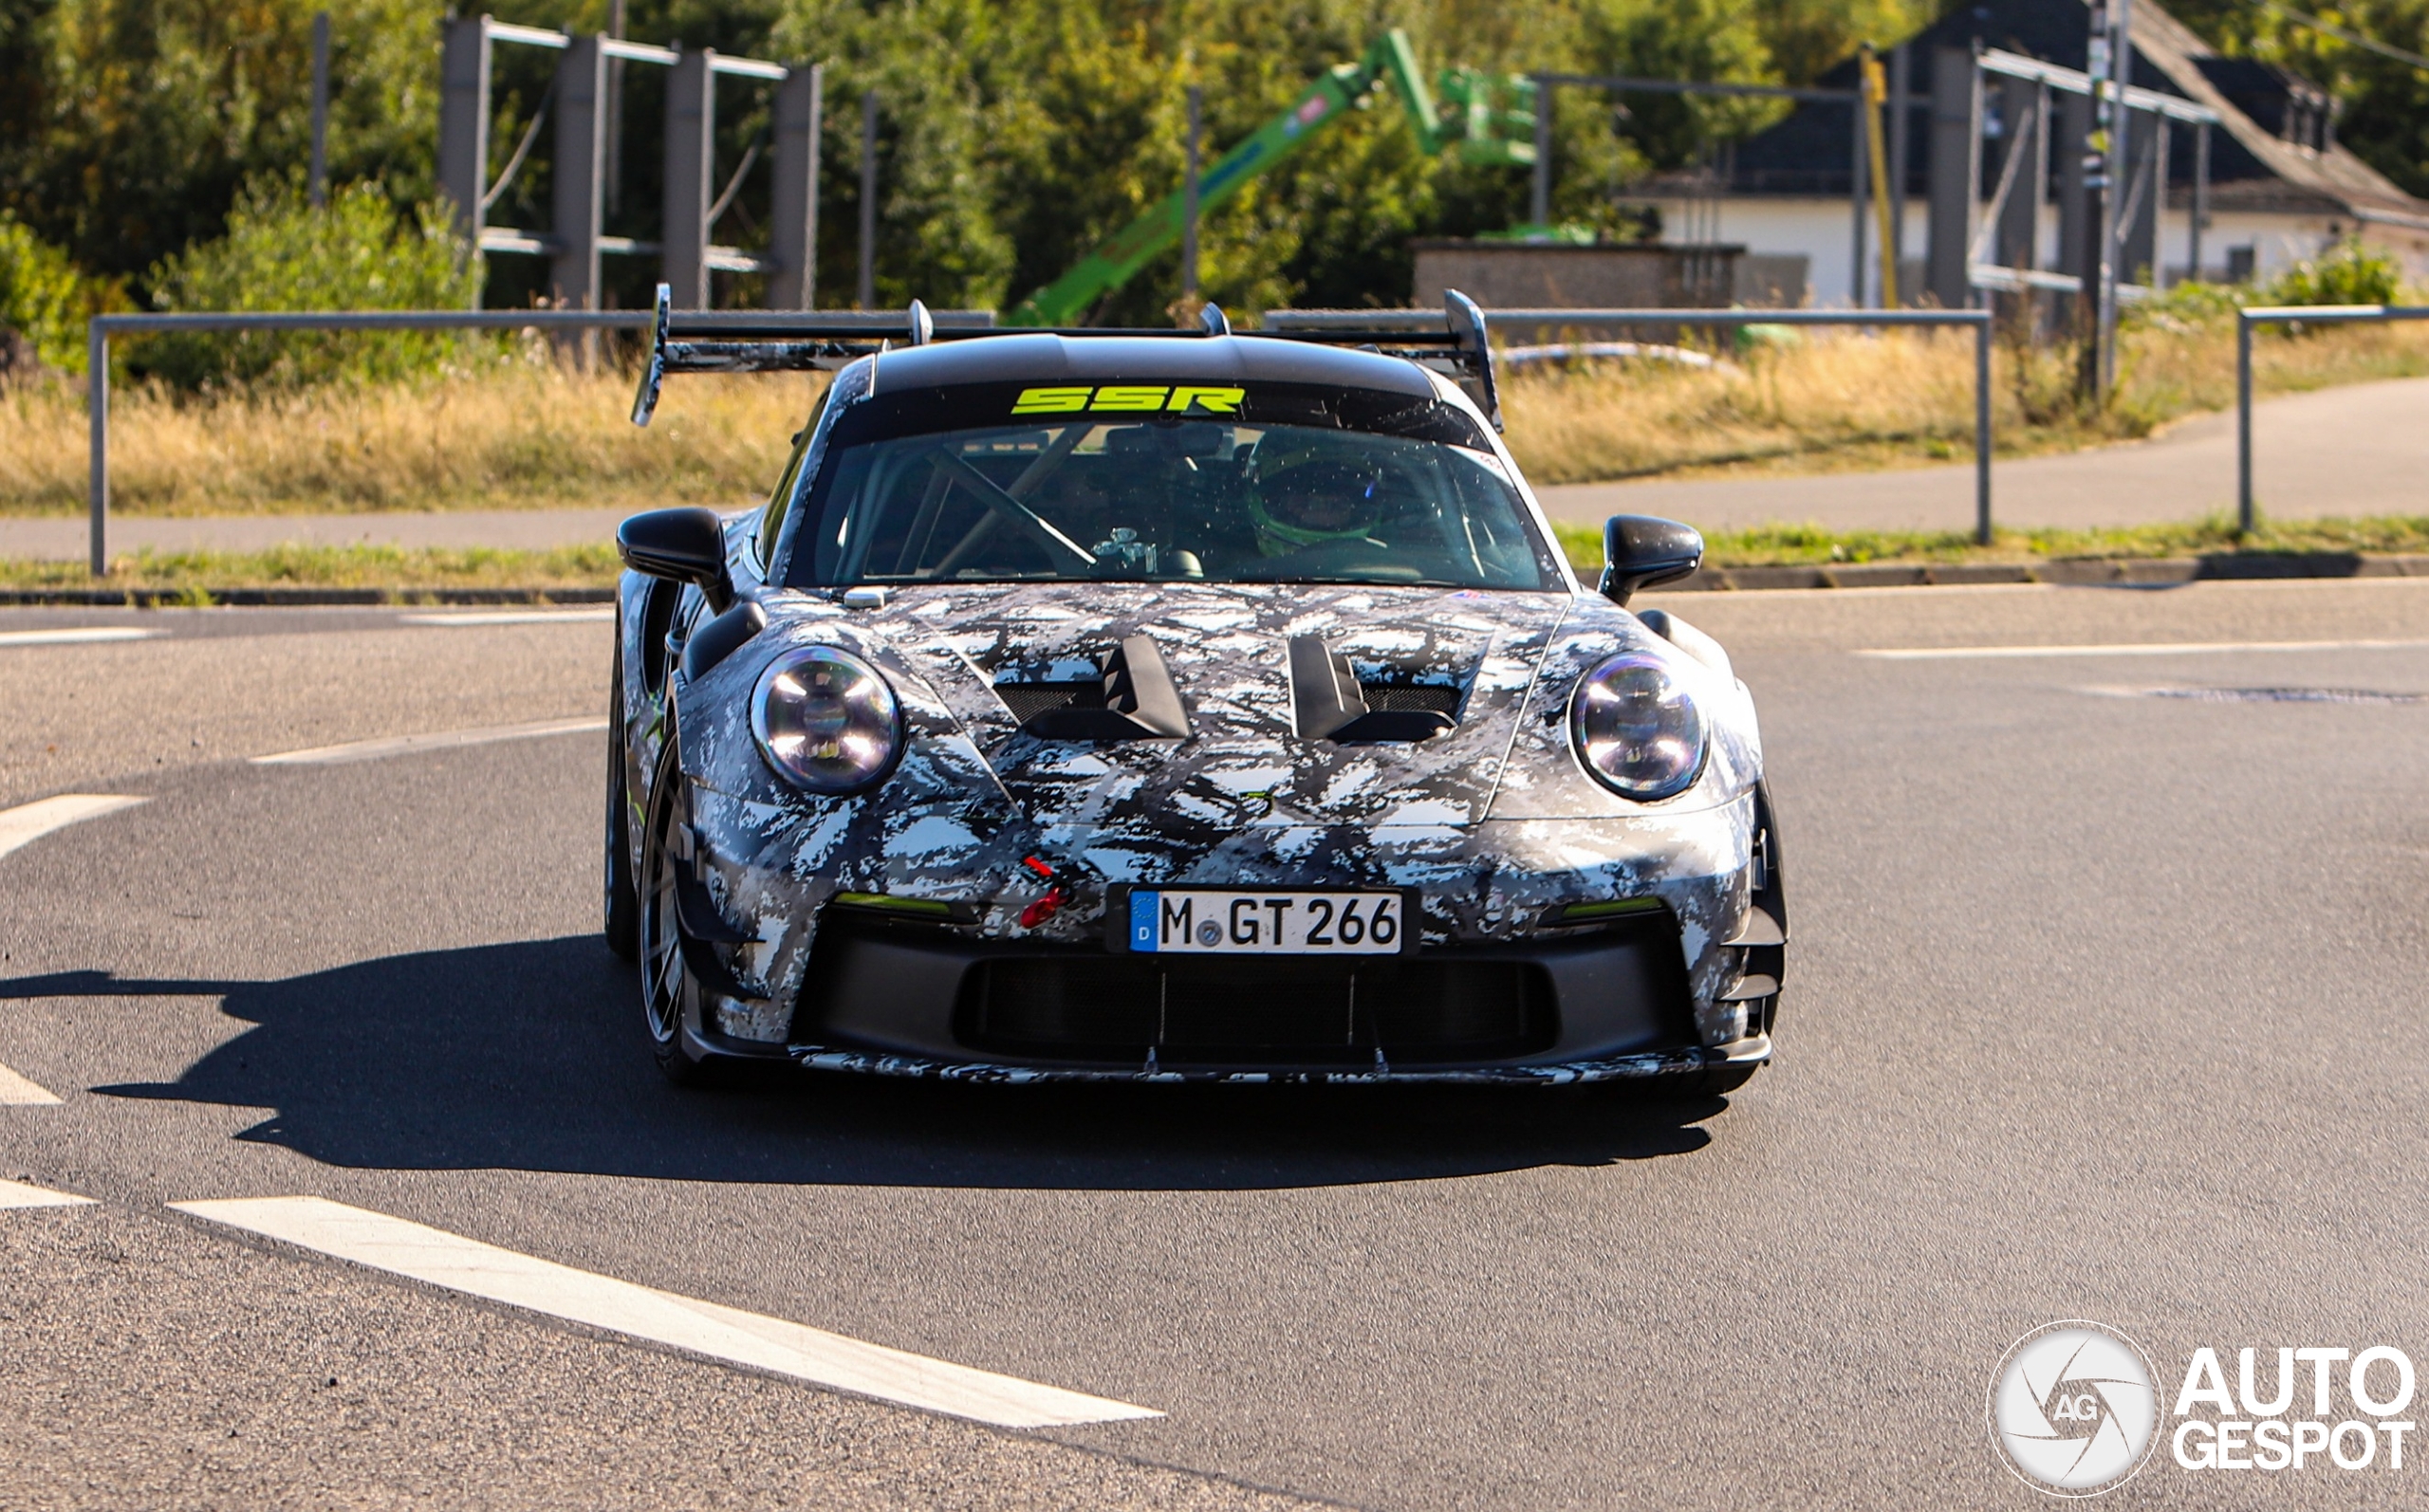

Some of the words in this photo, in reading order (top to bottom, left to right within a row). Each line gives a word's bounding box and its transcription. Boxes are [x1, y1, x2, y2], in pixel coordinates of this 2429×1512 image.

[1011, 386, 1245, 415] SSR
[1139, 927, 1150, 941] D
[1160, 897, 1192, 944] M
[1230, 898, 1293, 945] GT
[1306, 898, 1397, 945] 266
